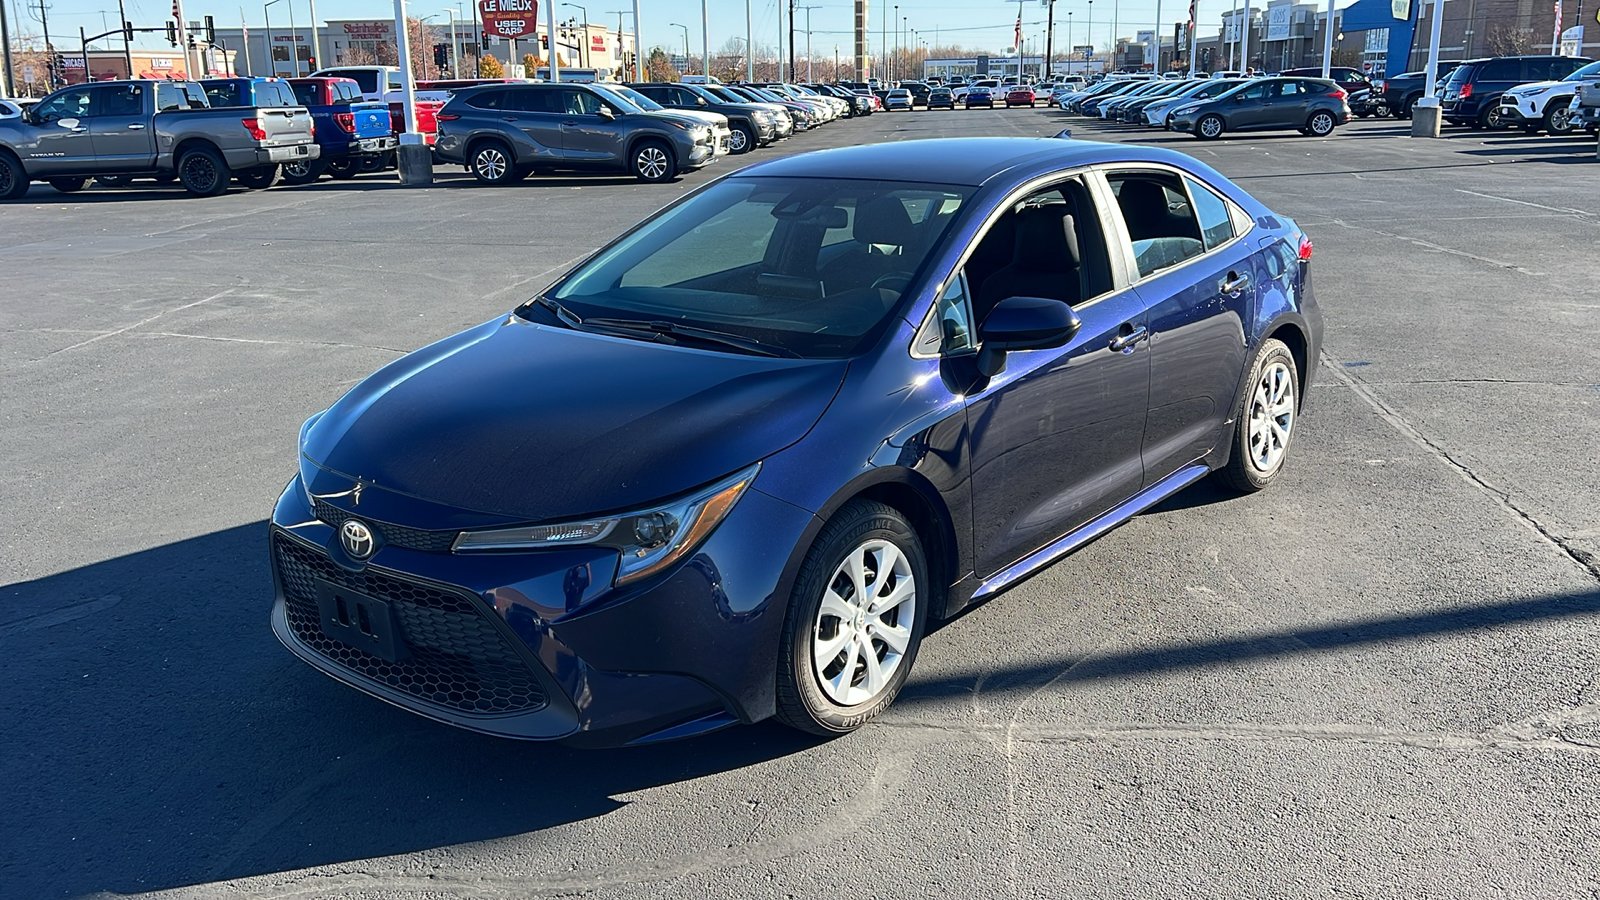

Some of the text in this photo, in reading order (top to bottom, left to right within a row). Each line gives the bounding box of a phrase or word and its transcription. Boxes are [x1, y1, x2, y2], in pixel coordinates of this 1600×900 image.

[484, 0, 533, 12] LE MIEUX
[1394, 1, 1408, 13] BUY
[494, 20, 526, 28] USED
[498, 27, 523, 35] CARS
